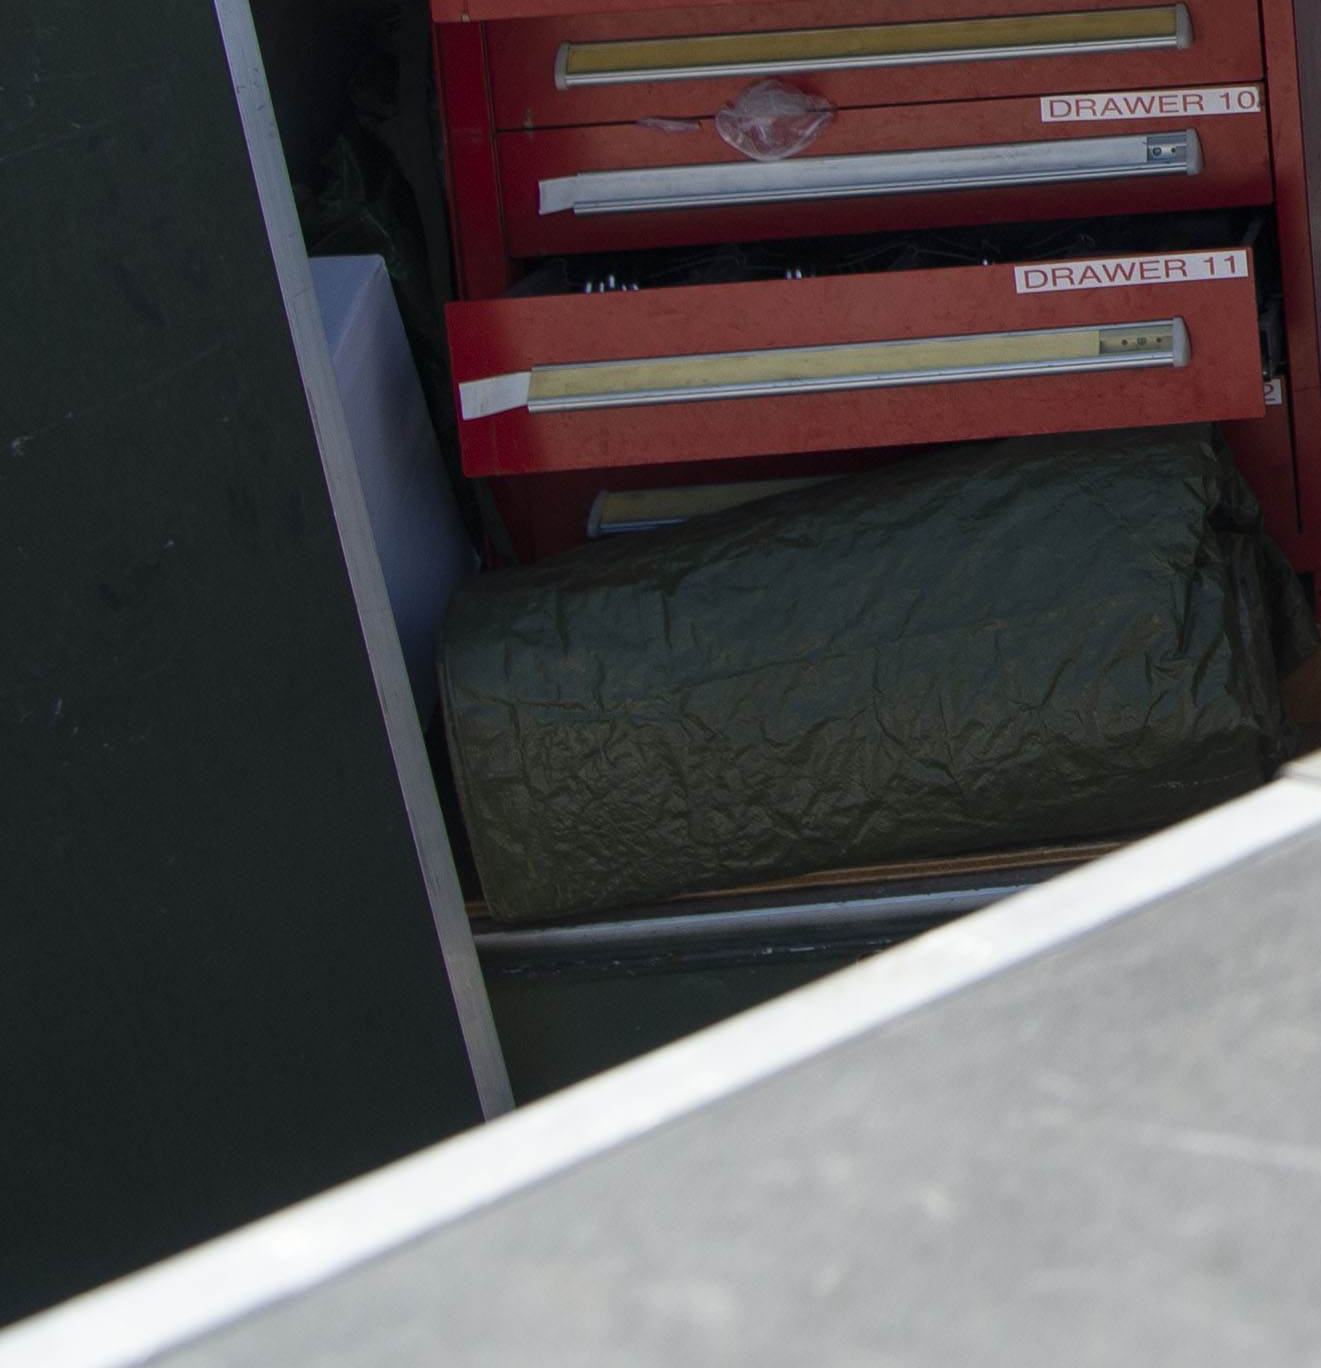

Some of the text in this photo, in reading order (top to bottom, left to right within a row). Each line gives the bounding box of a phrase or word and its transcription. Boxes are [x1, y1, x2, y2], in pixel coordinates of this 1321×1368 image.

[1049, 90, 1256, 119] DRAWER 10
[1023, 254, 1237, 290] DRAWER 11
